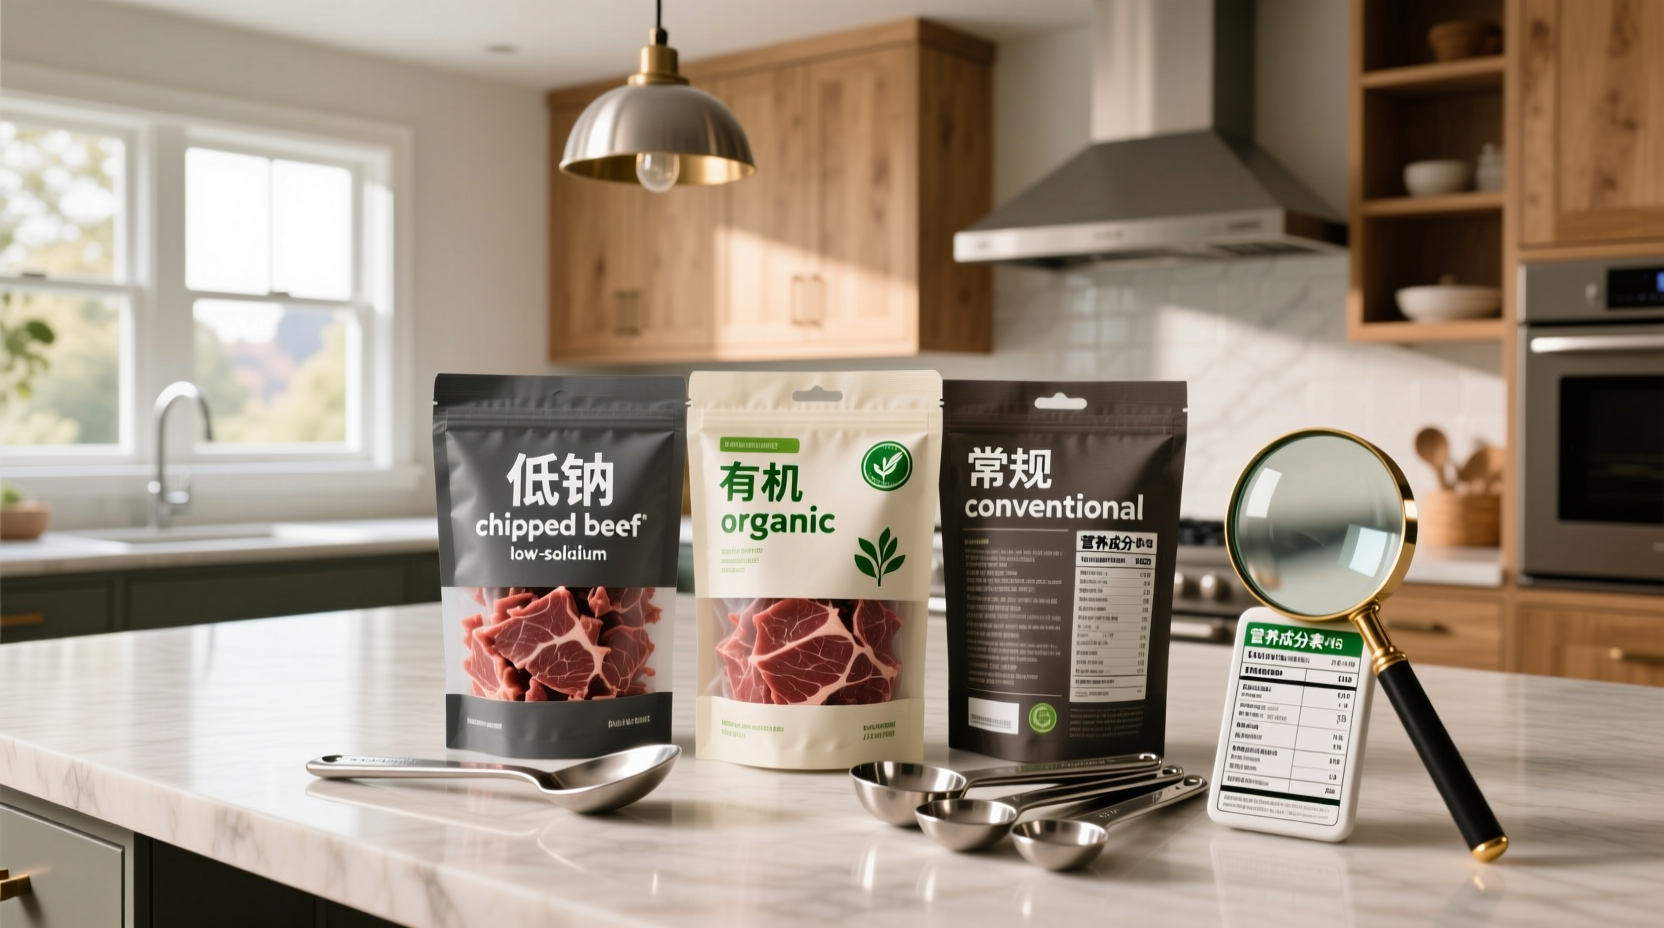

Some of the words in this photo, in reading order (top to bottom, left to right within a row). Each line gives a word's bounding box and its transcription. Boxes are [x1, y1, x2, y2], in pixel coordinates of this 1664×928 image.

[506, 452, 614, 507] 低钠
[719, 461, 803, 502] 有机
[968, 446, 1052, 489] 常规
[721, 505, 836, 541] organic
[965, 493, 1144, 520] conventional
[475, 512, 576, 542] chipped
